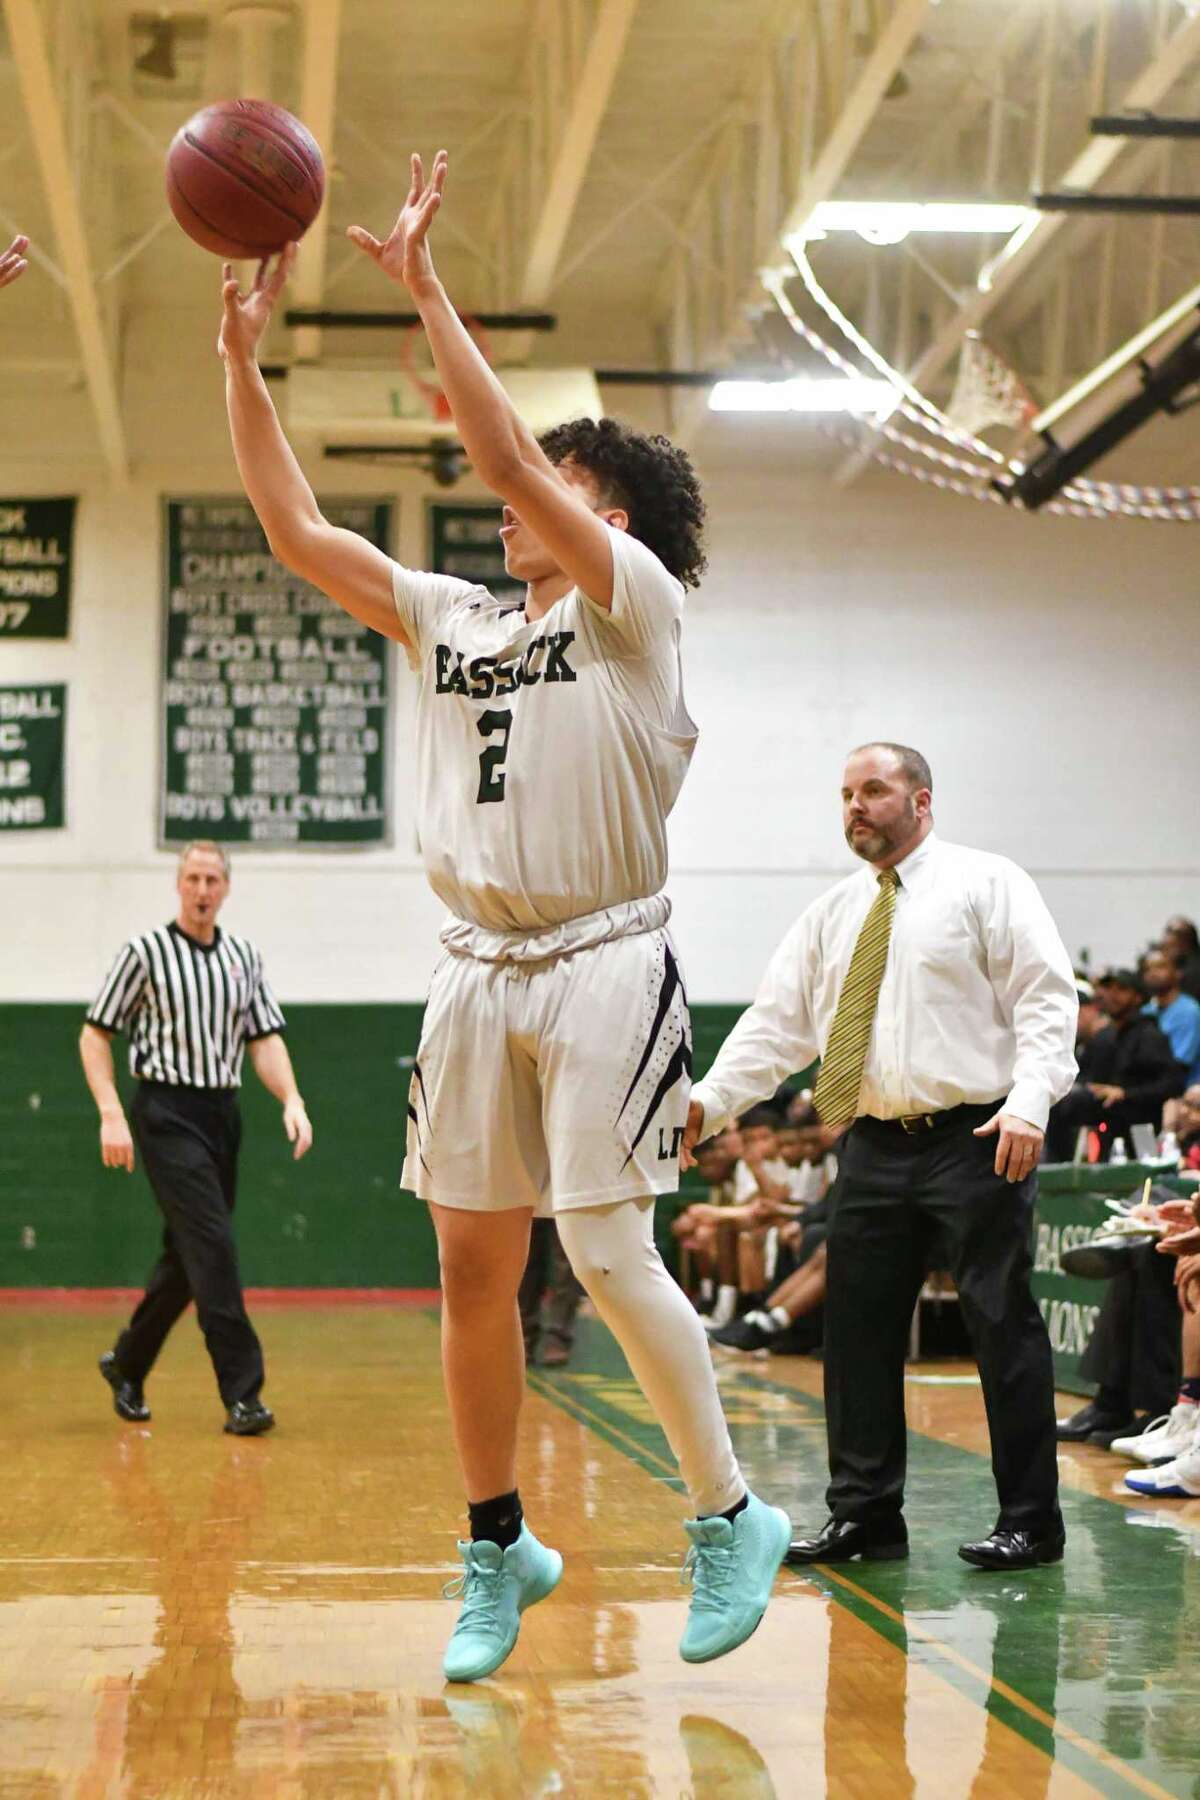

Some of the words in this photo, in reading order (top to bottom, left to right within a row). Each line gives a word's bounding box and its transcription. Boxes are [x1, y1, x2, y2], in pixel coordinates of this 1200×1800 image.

[184, 636, 371, 660] FOOTBALL
[435, 631, 577, 699] BASSCK
[168, 681, 226, 706] BOYS
[231, 683, 387, 707] BASKETBALL
[175, 729, 228, 753] BOYS
[233, 730, 296, 753] TRACK
[320, 730, 379, 754] FIELD
[476, 709, 513, 803] 2
[167, 792, 225, 821] BOYS
[230, 795, 384, 821] VOLLEYBALL
